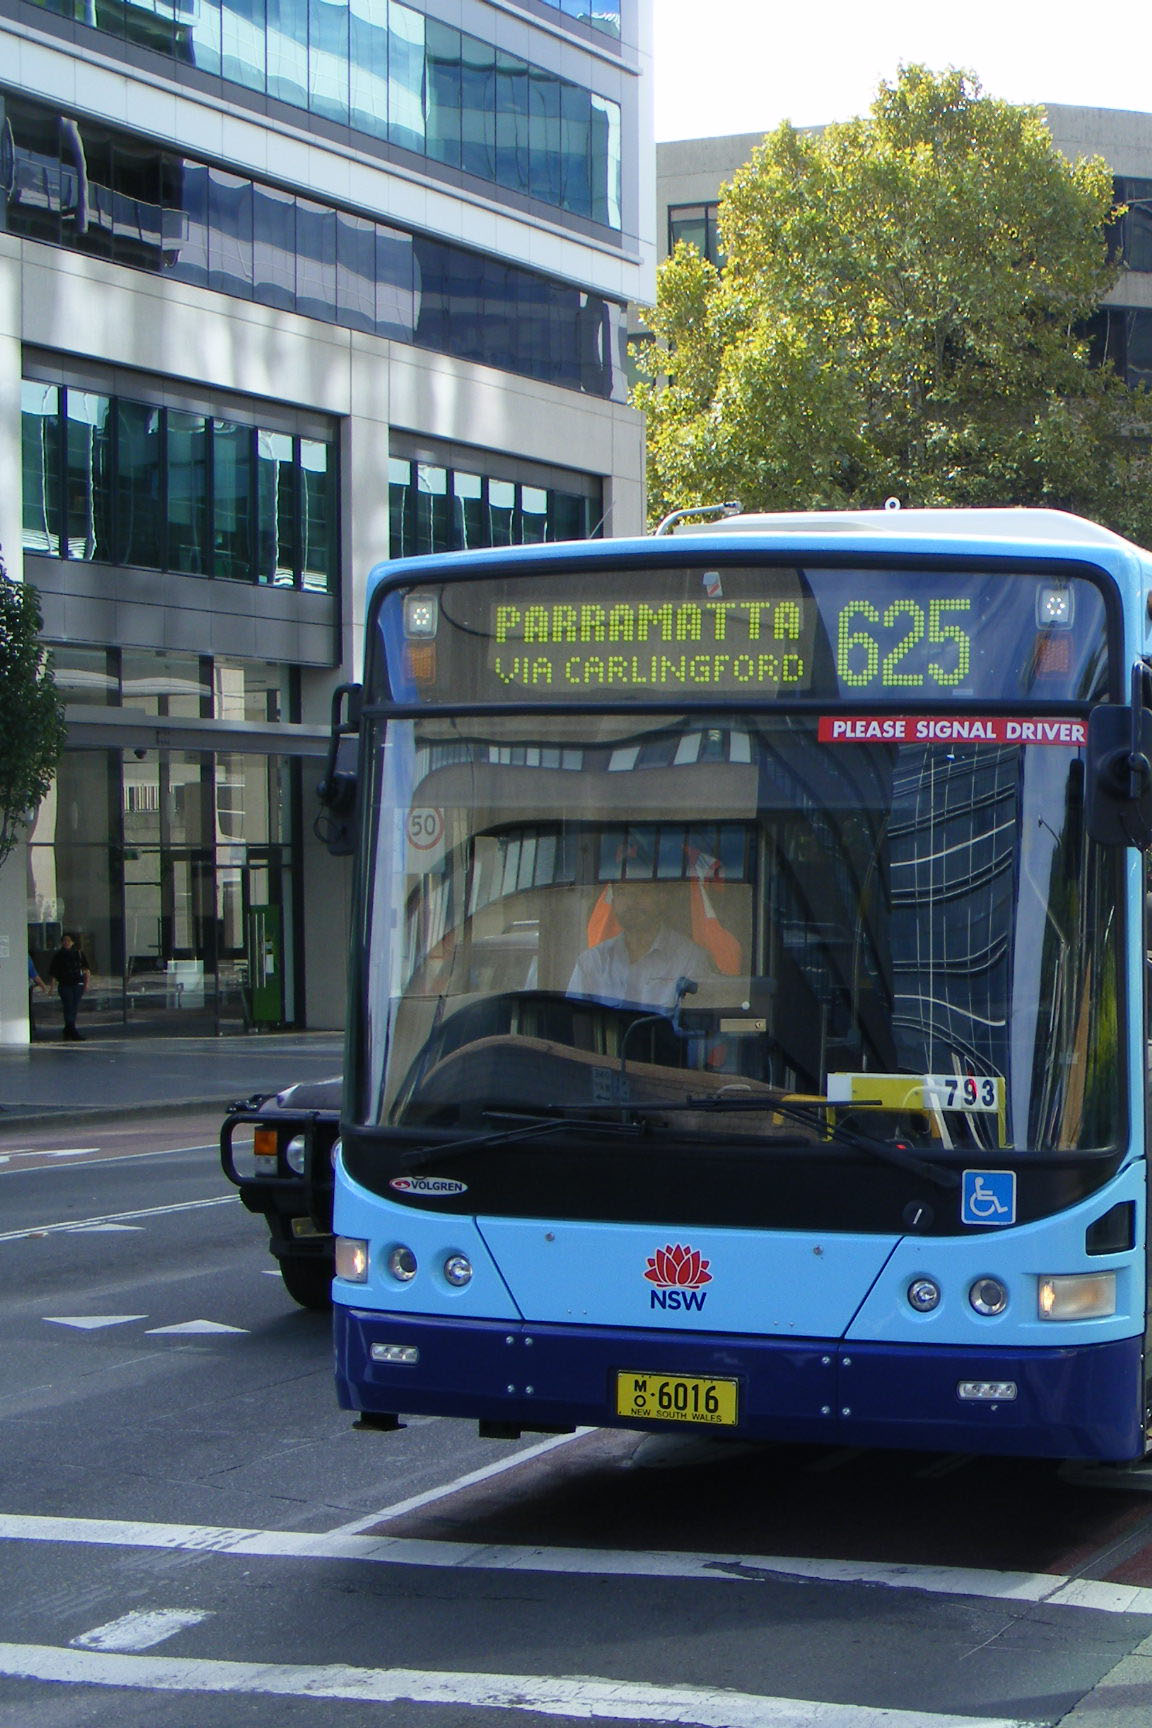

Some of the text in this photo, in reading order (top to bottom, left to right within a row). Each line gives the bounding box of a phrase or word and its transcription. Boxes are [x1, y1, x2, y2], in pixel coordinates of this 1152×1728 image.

[495, 602, 800, 643] PARRAMATTA
[837, 599, 972, 686] 625
[494, 654, 804, 684] VIA CARLINGFORD
[833, 720, 1086, 742] PLEASE SIGNAL DRIVER
[412, 815, 435, 836] 50
[945, 1079, 995, 1107] 793
[411, 1180, 463, 1192] VOLGREN
[650, 1289, 707, 1312] NSW
[658, 1381, 719, 1413] 6016
[630, 1408, 723, 1423] NEW SOUTH WALES
